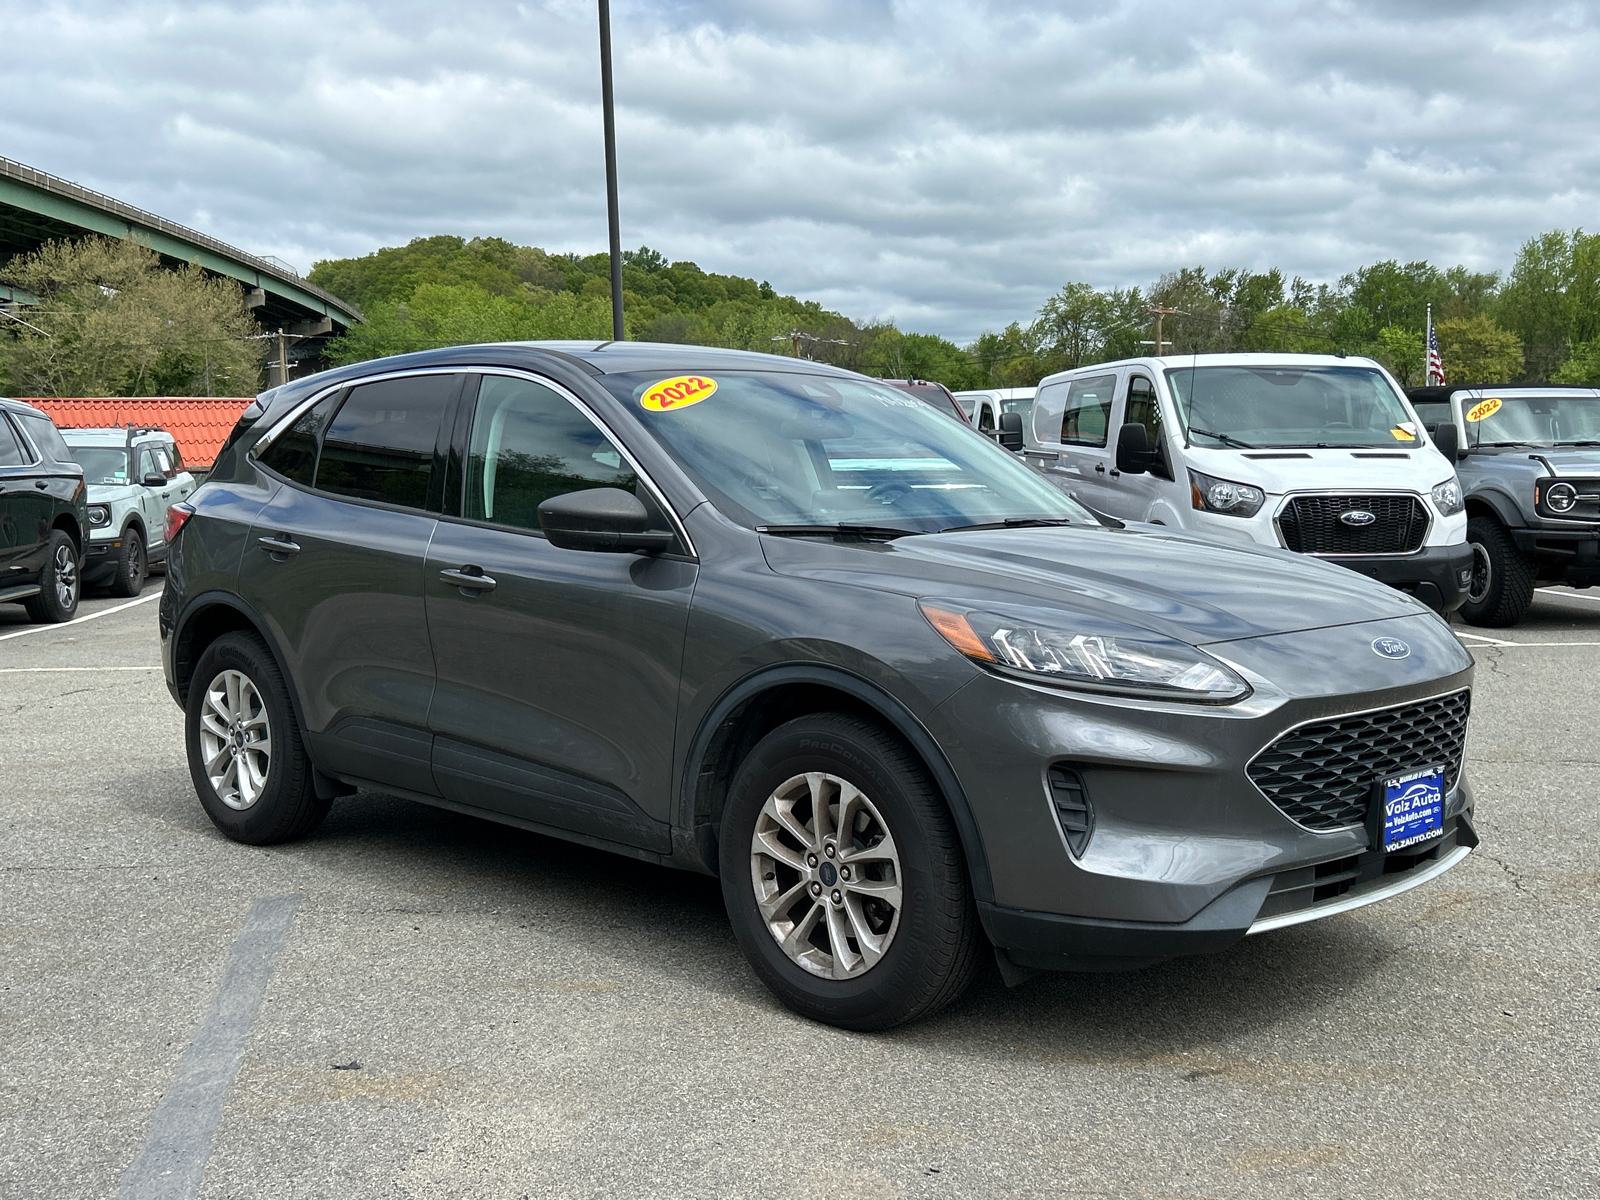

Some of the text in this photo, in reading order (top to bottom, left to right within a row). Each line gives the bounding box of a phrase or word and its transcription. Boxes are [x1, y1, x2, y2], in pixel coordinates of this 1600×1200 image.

[650, 377, 712, 408] 2022
[1471, 400, 1499, 420] 2022
[1381, 640, 1404, 653] Ford
[1386, 793, 1441, 816] Volz Auto
[1394, 808, 1432, 826] VolzAuto.com
[1386, 829, 1443, 852] VOLZAUTO.COM
